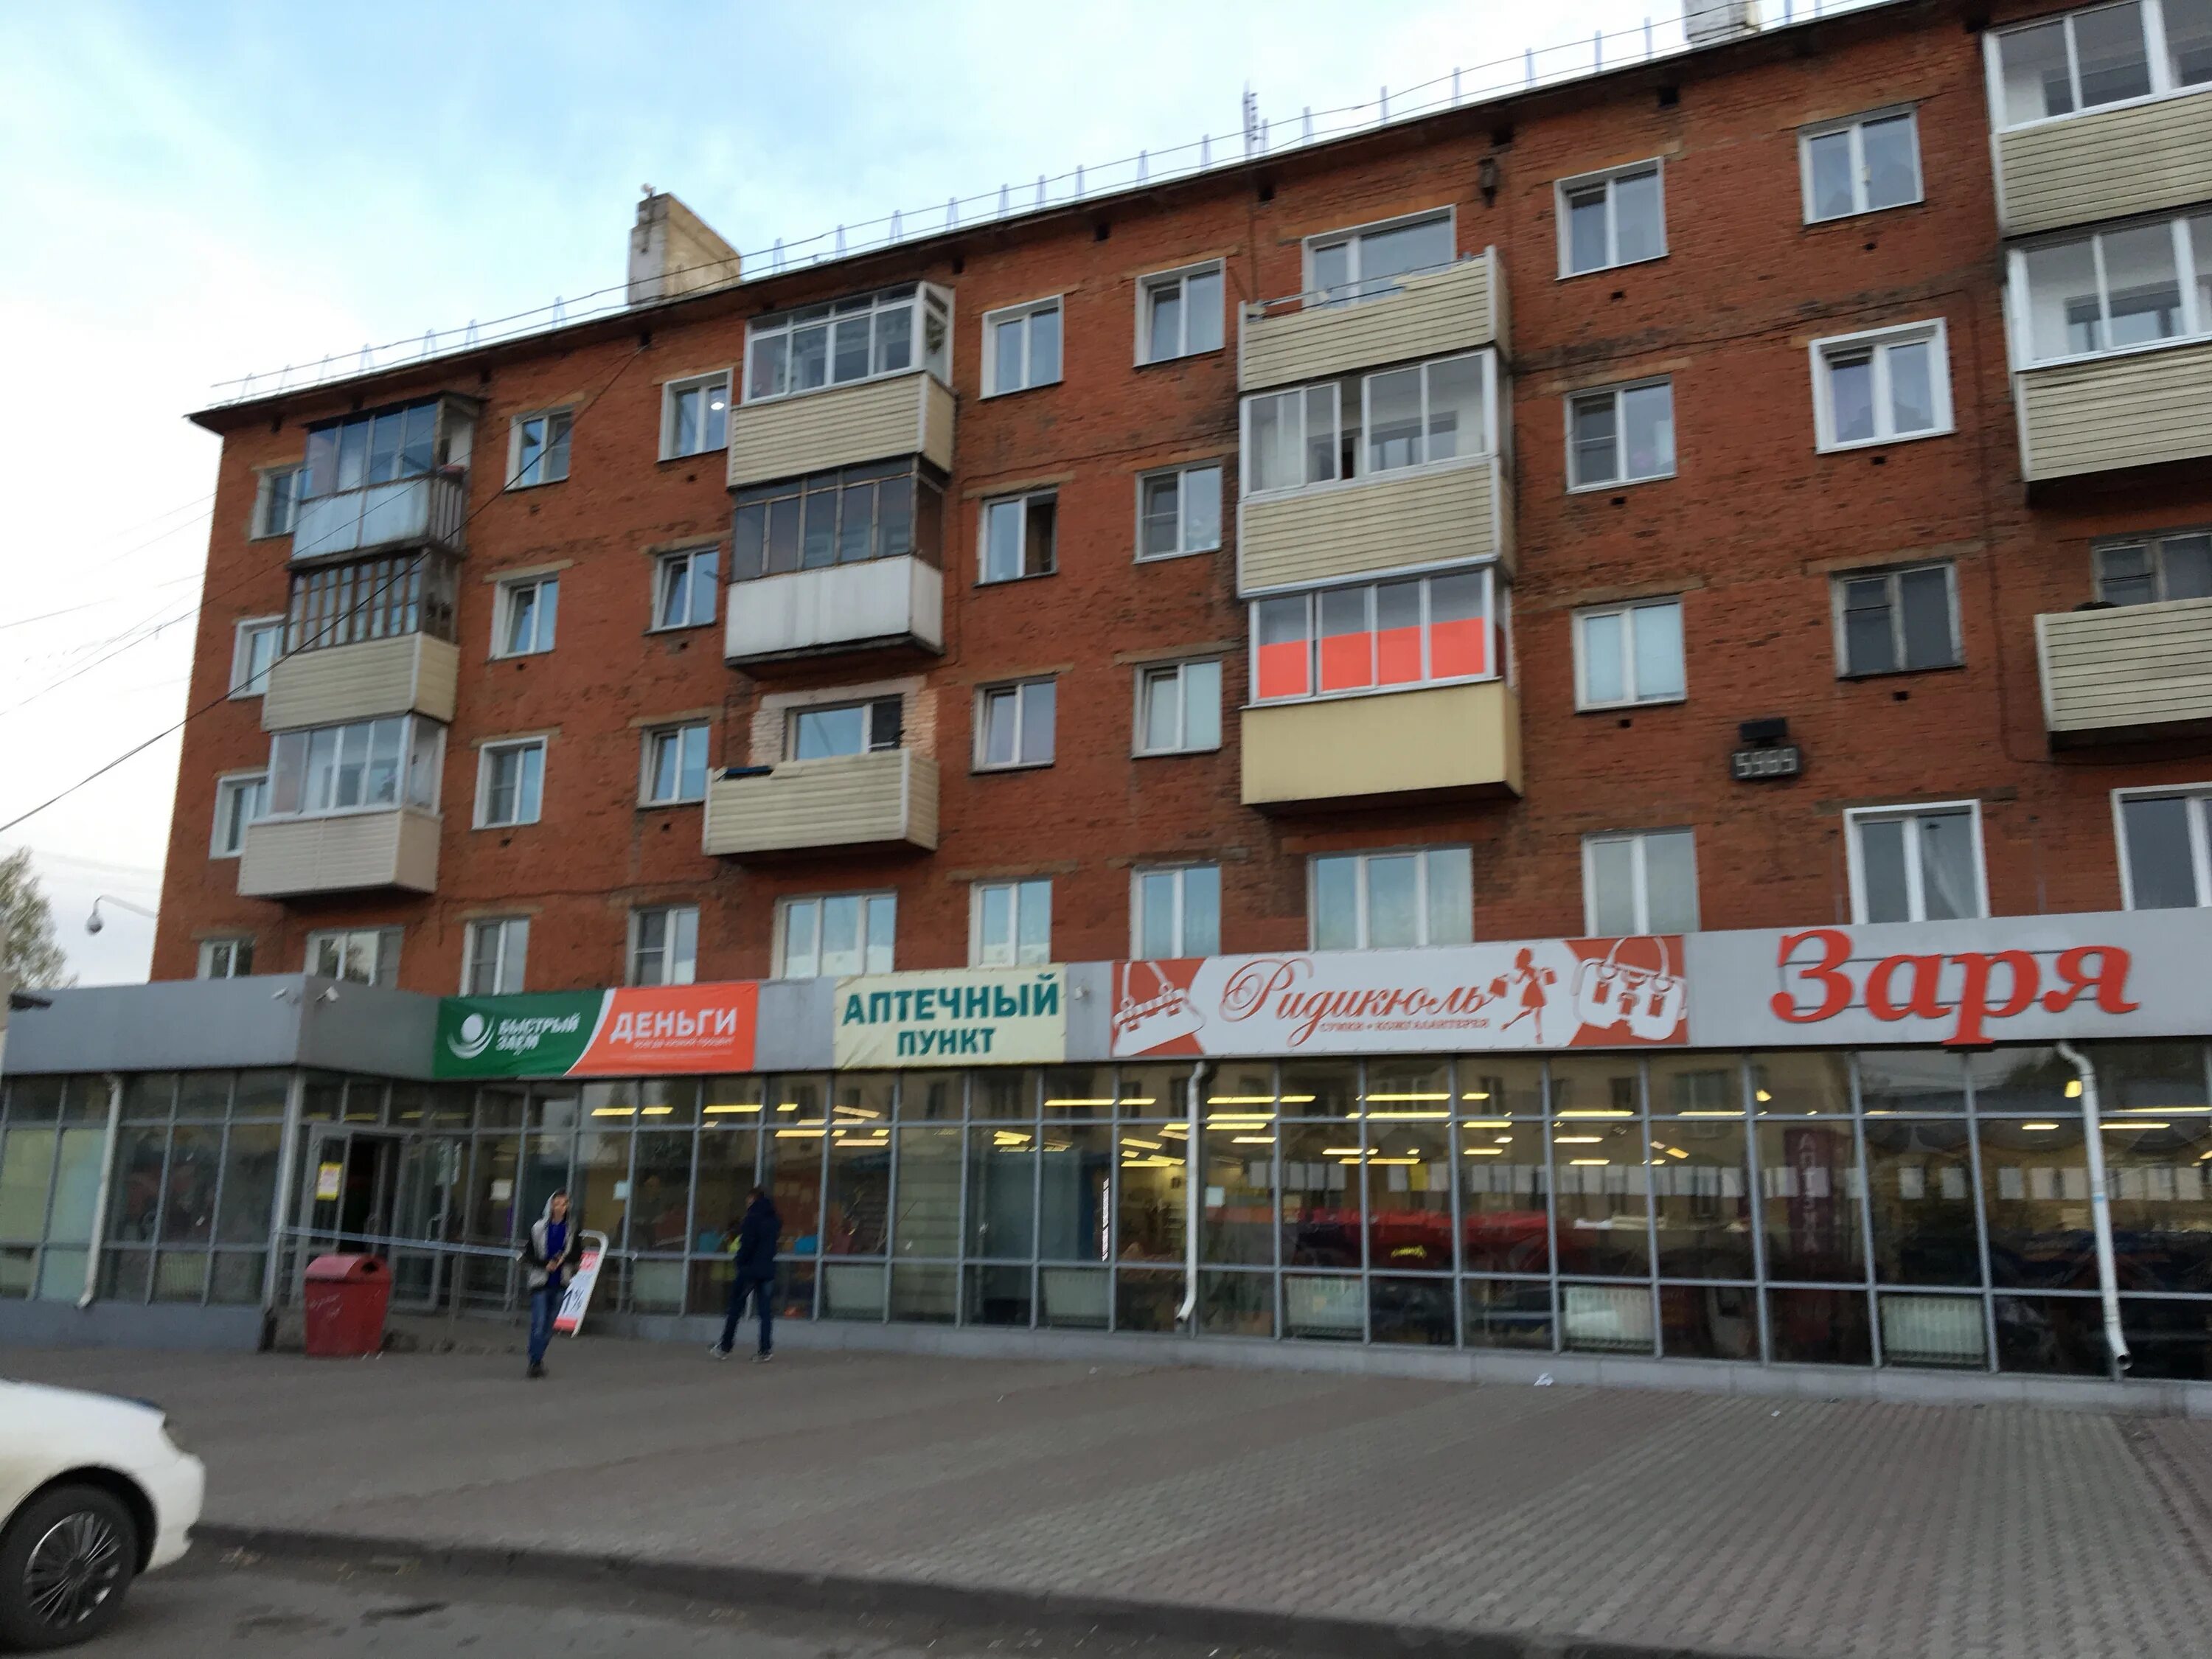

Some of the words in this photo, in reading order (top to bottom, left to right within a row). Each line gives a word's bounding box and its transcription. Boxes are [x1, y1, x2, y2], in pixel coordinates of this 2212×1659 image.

[842, 973, 1060, 1026] АПТЕЧНЫЙ
[1220, 957, 1494, 1048] Ридикюль
[1770, 928, 2140, 1046] Заря
[498, 1012, 580, 1035] БЫСТРЫЙ
[609, 1007, 737, 1045] ДЕНЬГИ
[897, 1026, 996, 1057] ПУНКТ
